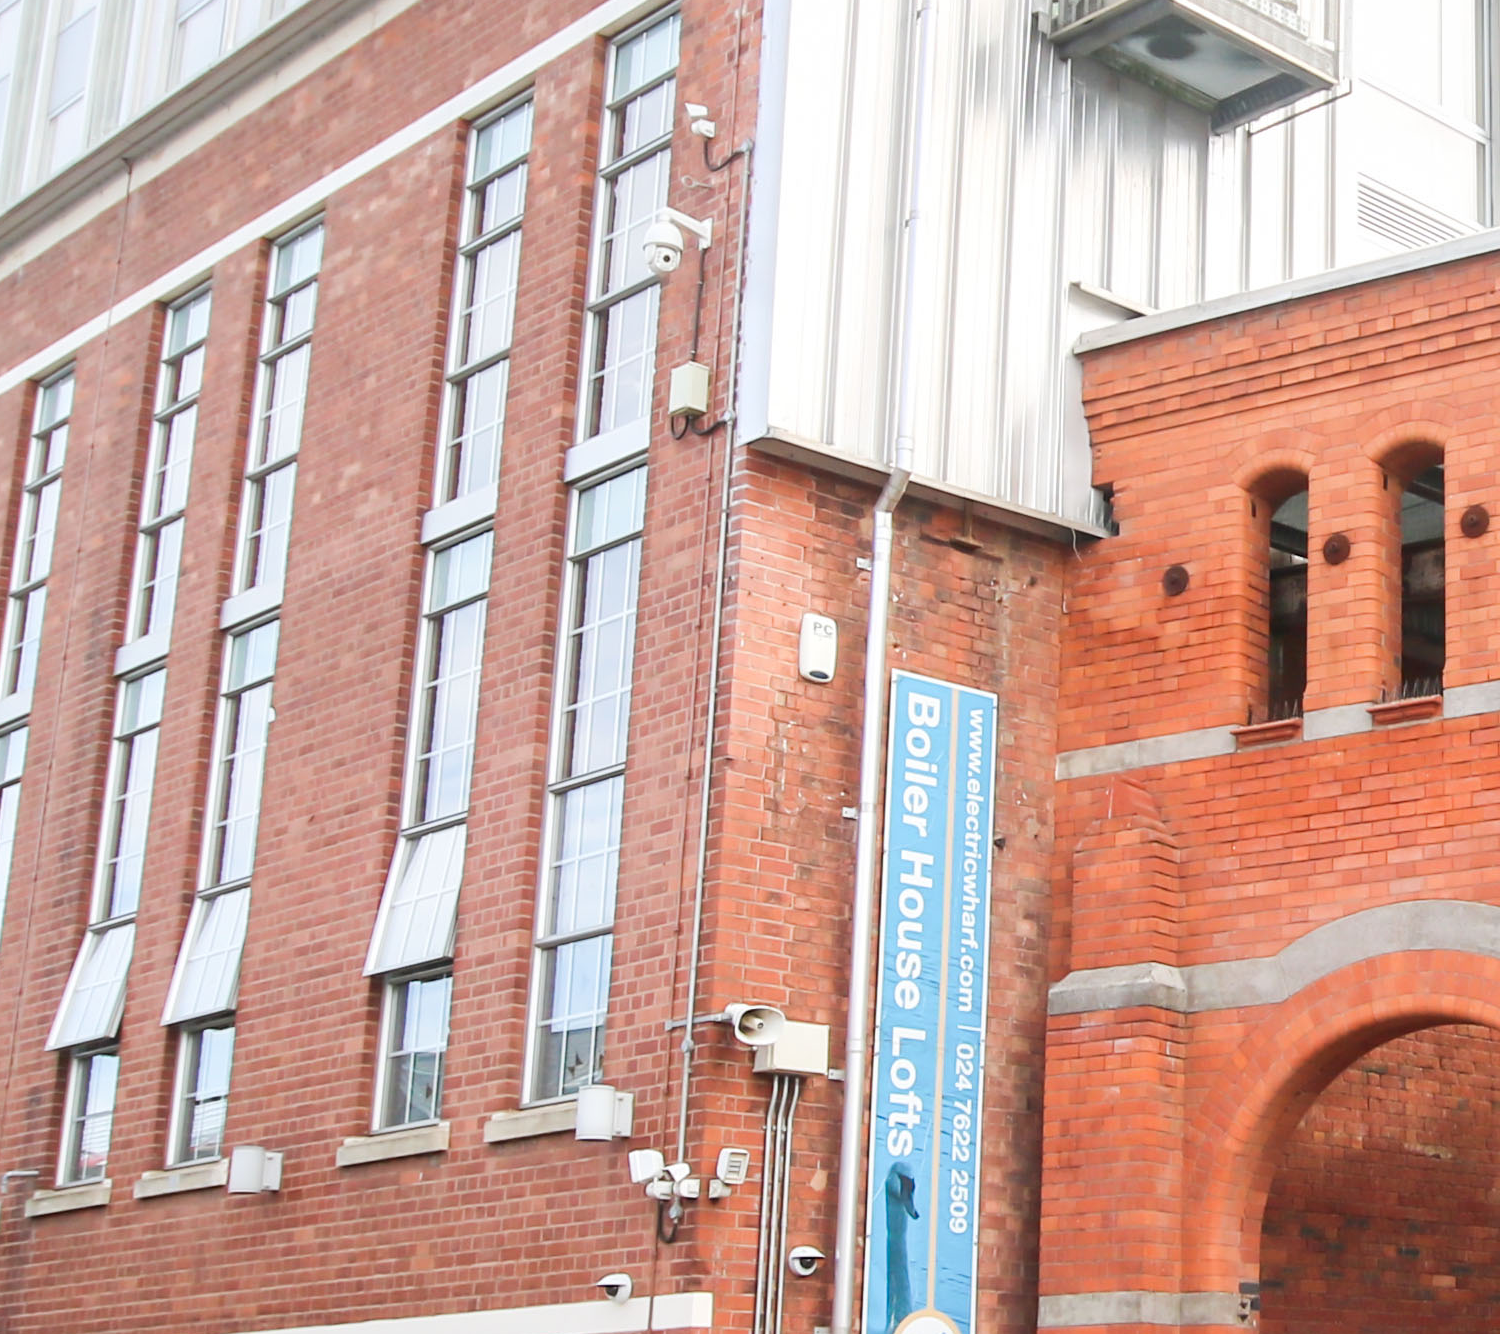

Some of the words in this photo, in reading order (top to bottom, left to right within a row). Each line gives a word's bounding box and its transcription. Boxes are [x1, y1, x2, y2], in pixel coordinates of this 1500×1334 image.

[902, 691, 941, 838] Boiler
[957, 708, 984, 1013] www.electricwharf.com
[894, 849, 934, 1011] House
[886, 1026, 927, 1157] Lofts
[952, 1099, 972, 1162] 7622
[954, 1043, 975, 1091] 024
[949, 1170, 969, 1234] 2509
